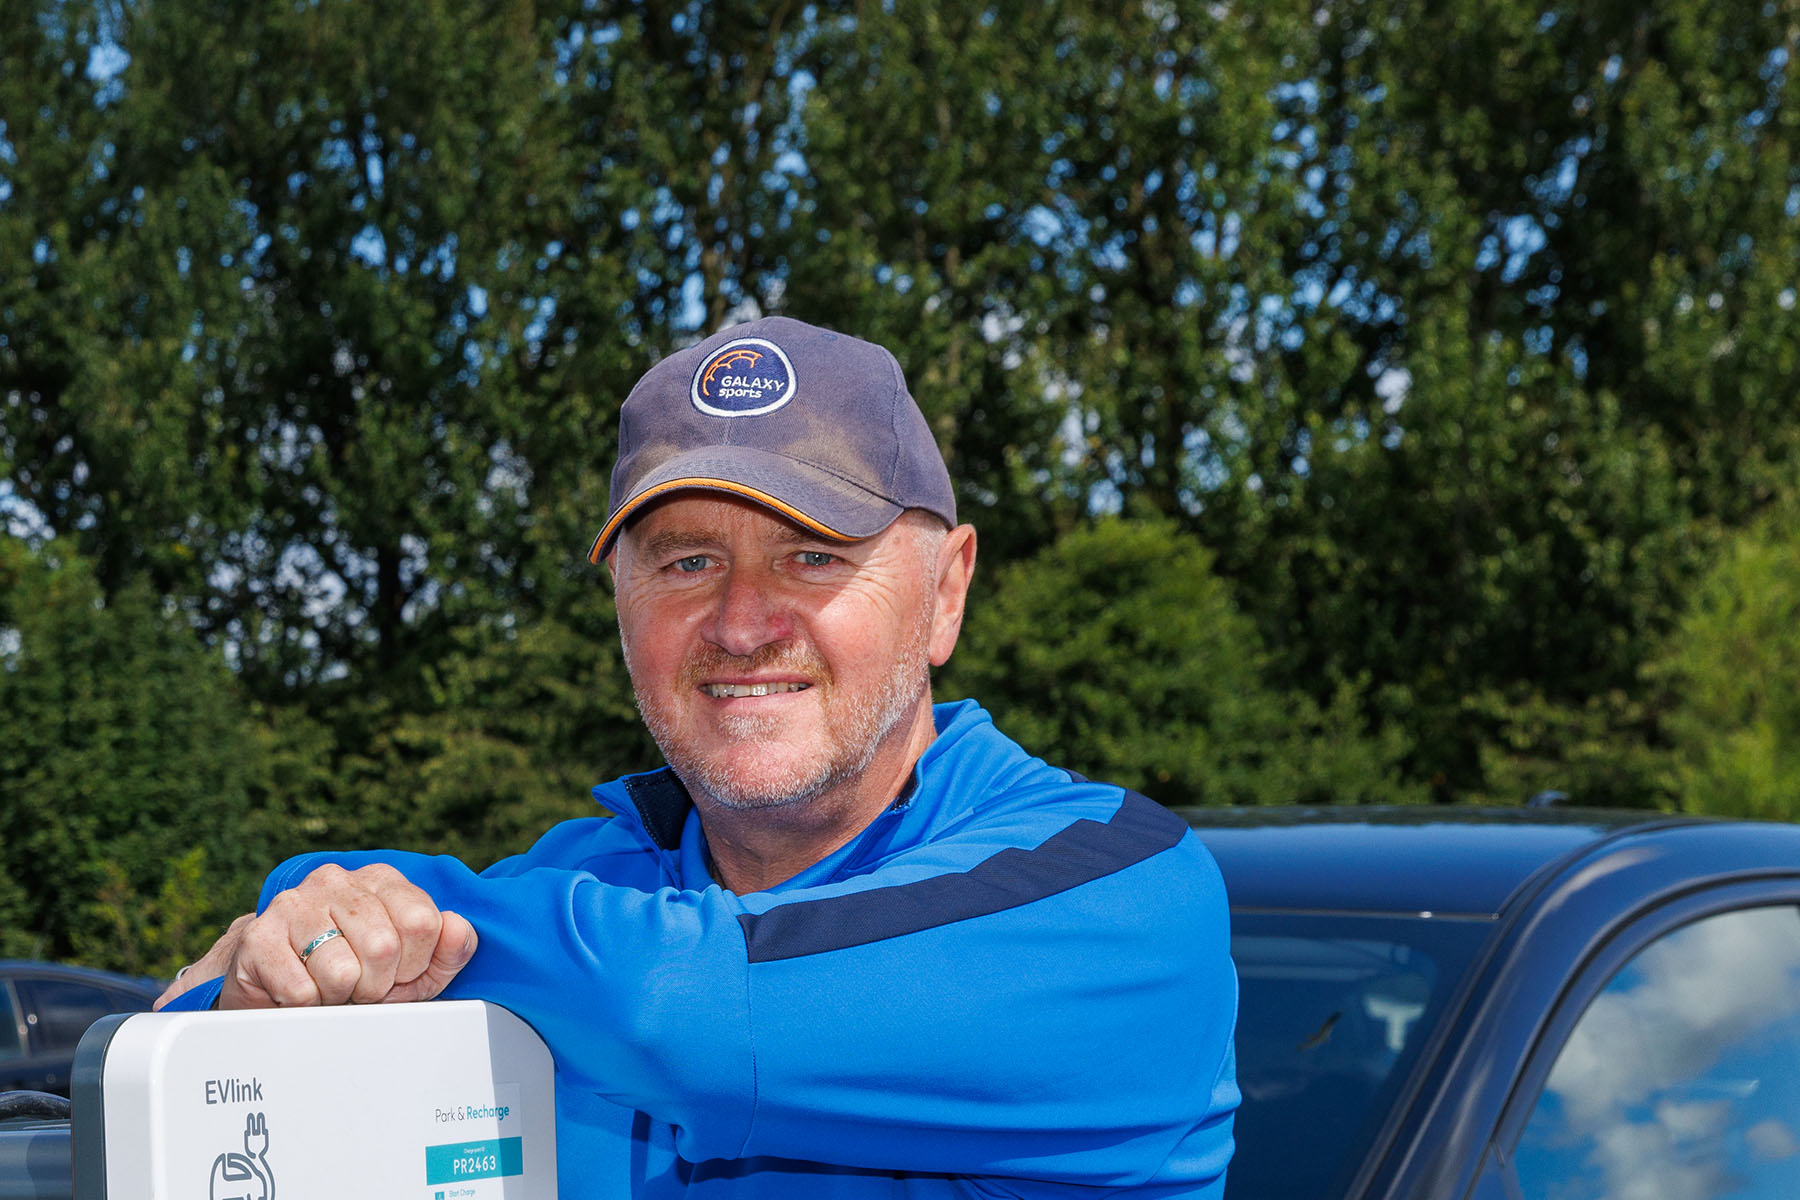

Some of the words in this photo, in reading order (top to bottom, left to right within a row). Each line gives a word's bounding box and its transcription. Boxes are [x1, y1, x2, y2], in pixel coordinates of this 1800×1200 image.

[719, 387, 762, 398] sports
[721, 375, 785, 392] GALAXY
[205, 1077, 263, 1104] EVlink
[435, 1106, 456, 1123] Park
[457, 1106, 465, 1121] &
[466, 1104, 510, 1121] Recharge
[453, 1155, 496, 1175] PR2463
[460, 1188, 476, 1198] Charge
